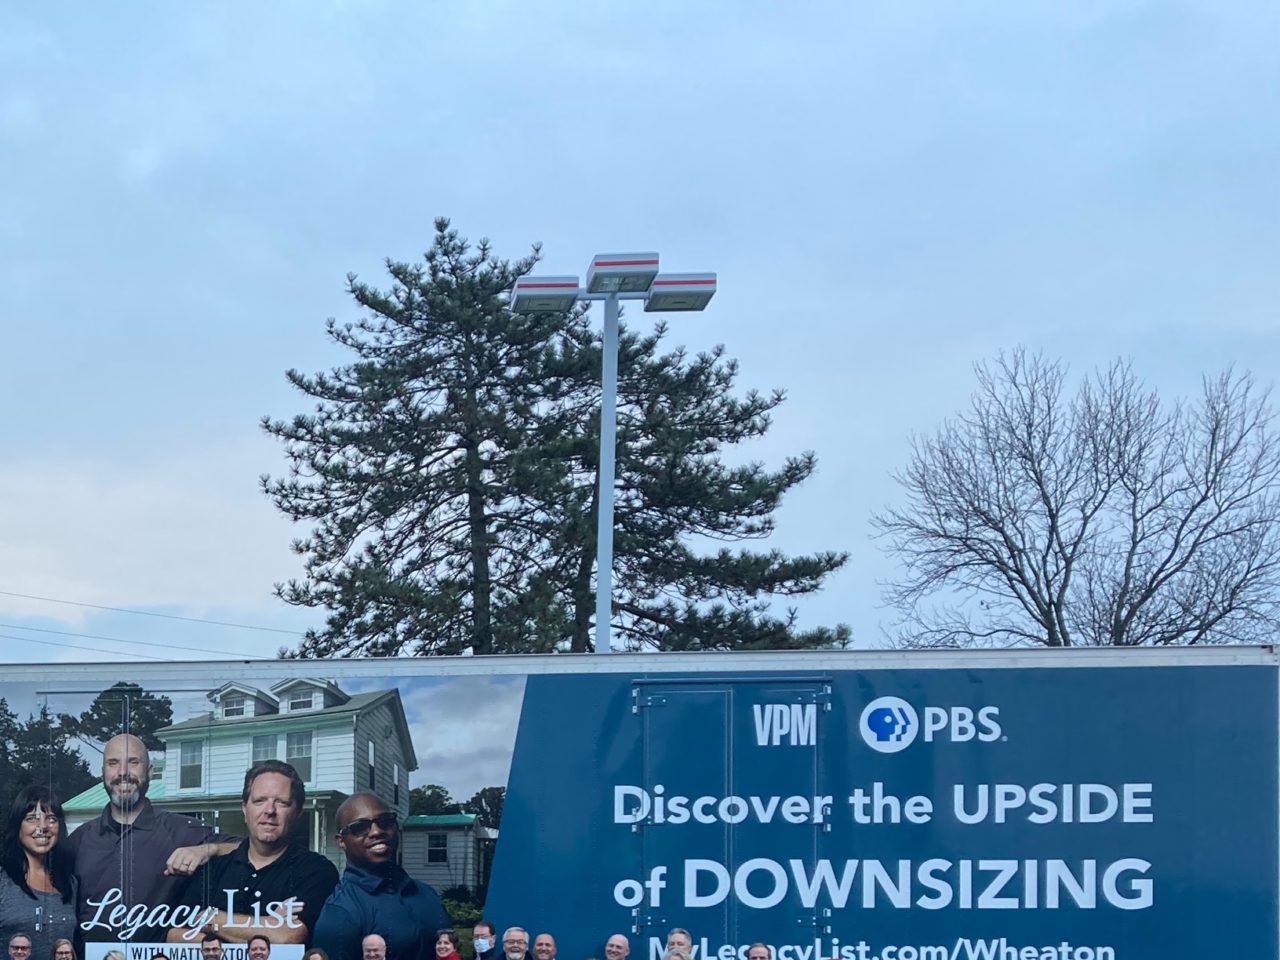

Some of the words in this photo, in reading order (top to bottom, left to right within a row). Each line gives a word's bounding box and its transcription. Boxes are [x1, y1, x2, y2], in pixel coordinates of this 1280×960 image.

[753, 703, 816, 746] VPM
[614, 784, 833, 824] Discover
[849, 782, 933, 824] the
[954, 782, 1154, 824] UPSIDE
[614, 865, 667, 908] of
[684, 858, 1154, 910] DOWNSIZING
[80, 887, 216, 940] Legacy
[222, 887, 304, 929] List
[169, 947, 202, 960] MATT
